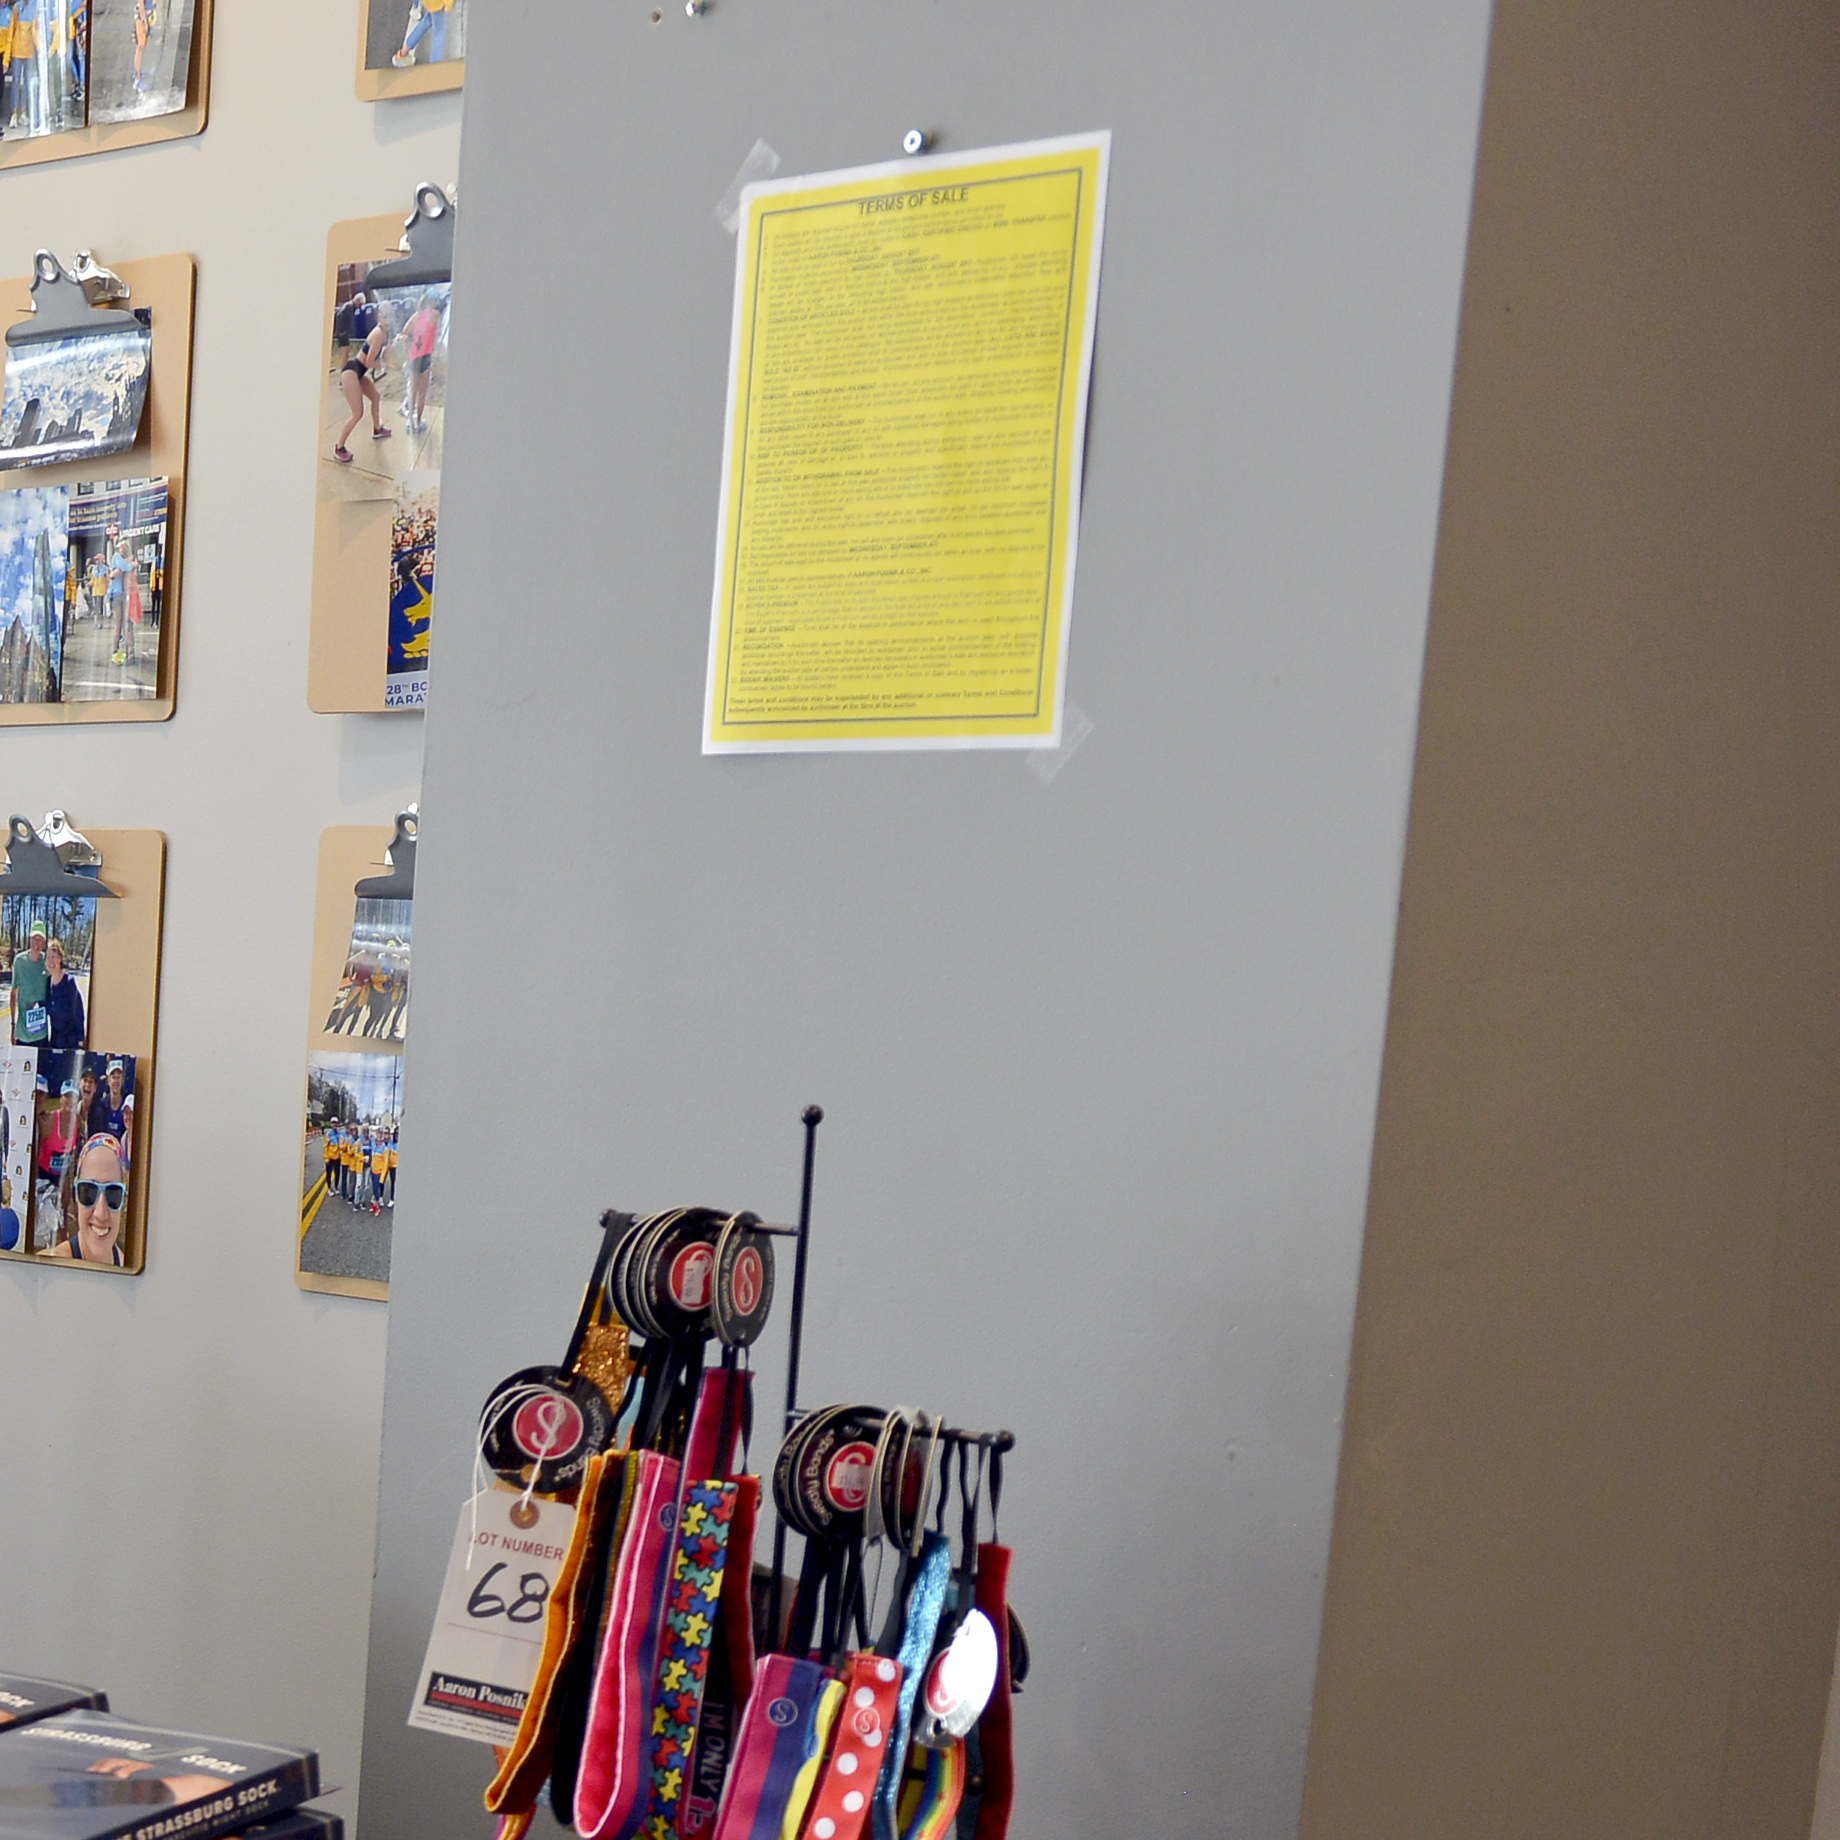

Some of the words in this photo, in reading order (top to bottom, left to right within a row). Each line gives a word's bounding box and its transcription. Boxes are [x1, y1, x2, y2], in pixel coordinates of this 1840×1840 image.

[859, 195, 902, 216] TERMS
[907, 191, 927, 211] OF
[931, 187, 970, 206] SALE
[501, 1537, 565, 1561] NUMBER
[467, 1561, 550, 1623] 68
[432, 1676, 476, 1701] Aaron
[479, 1683, 529, 1710] Posnik
[237, 1778, 279, 1808] SOCK
